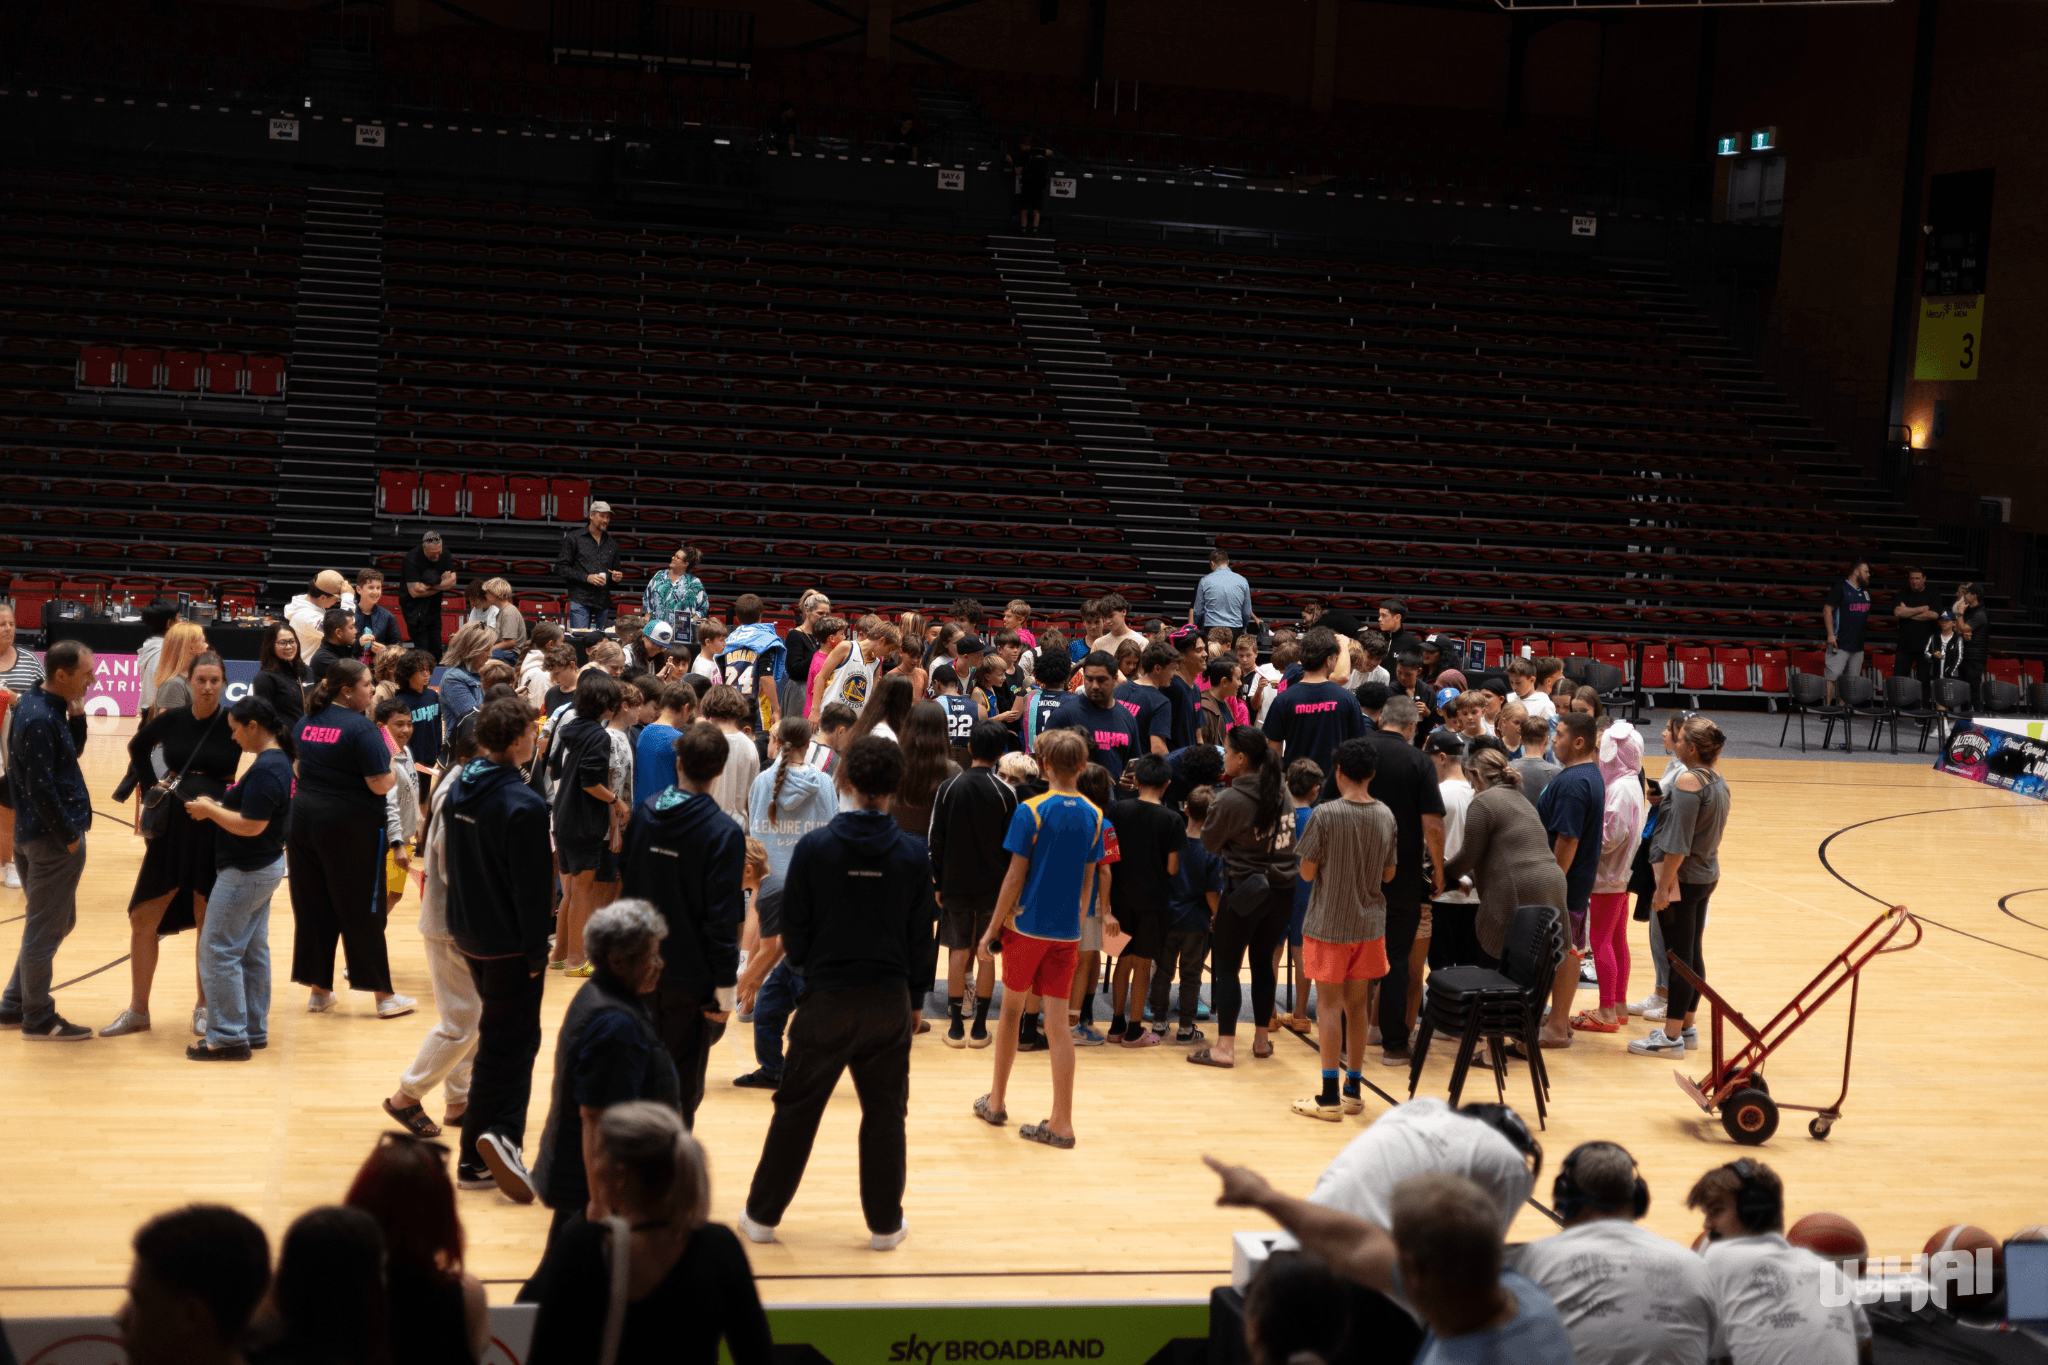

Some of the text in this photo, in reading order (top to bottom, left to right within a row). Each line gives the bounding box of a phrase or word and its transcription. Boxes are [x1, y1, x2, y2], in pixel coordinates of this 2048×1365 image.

[273, 122, 289, 130] BAY
[359, 128, 375, 136] BAY
[1053, 180, 1066, 188] BAY
[1953, 301, 1977, 311] BAYPARK
[1926, 309, 1946, 320] Mercury
[1953, 310, 1968, 318] ARENA
[1959, 333, 1975, 370] 3
[725, 665, 754, 695] 24
[1038, 700, 1061, 708] JACKSON
[1295, 701, 1338, 714] MOPPET
[946, 714, 973, 737] 22
[301, 725, 342, 744] CREW
[1951, 733, 1992, 758] ALTERNATIVE
[2003, 737, 2026, 751] Proud
[754, 819, 802, 835] LEISURE
[888, 1332, 1105, 1365] sky BROADBAND
